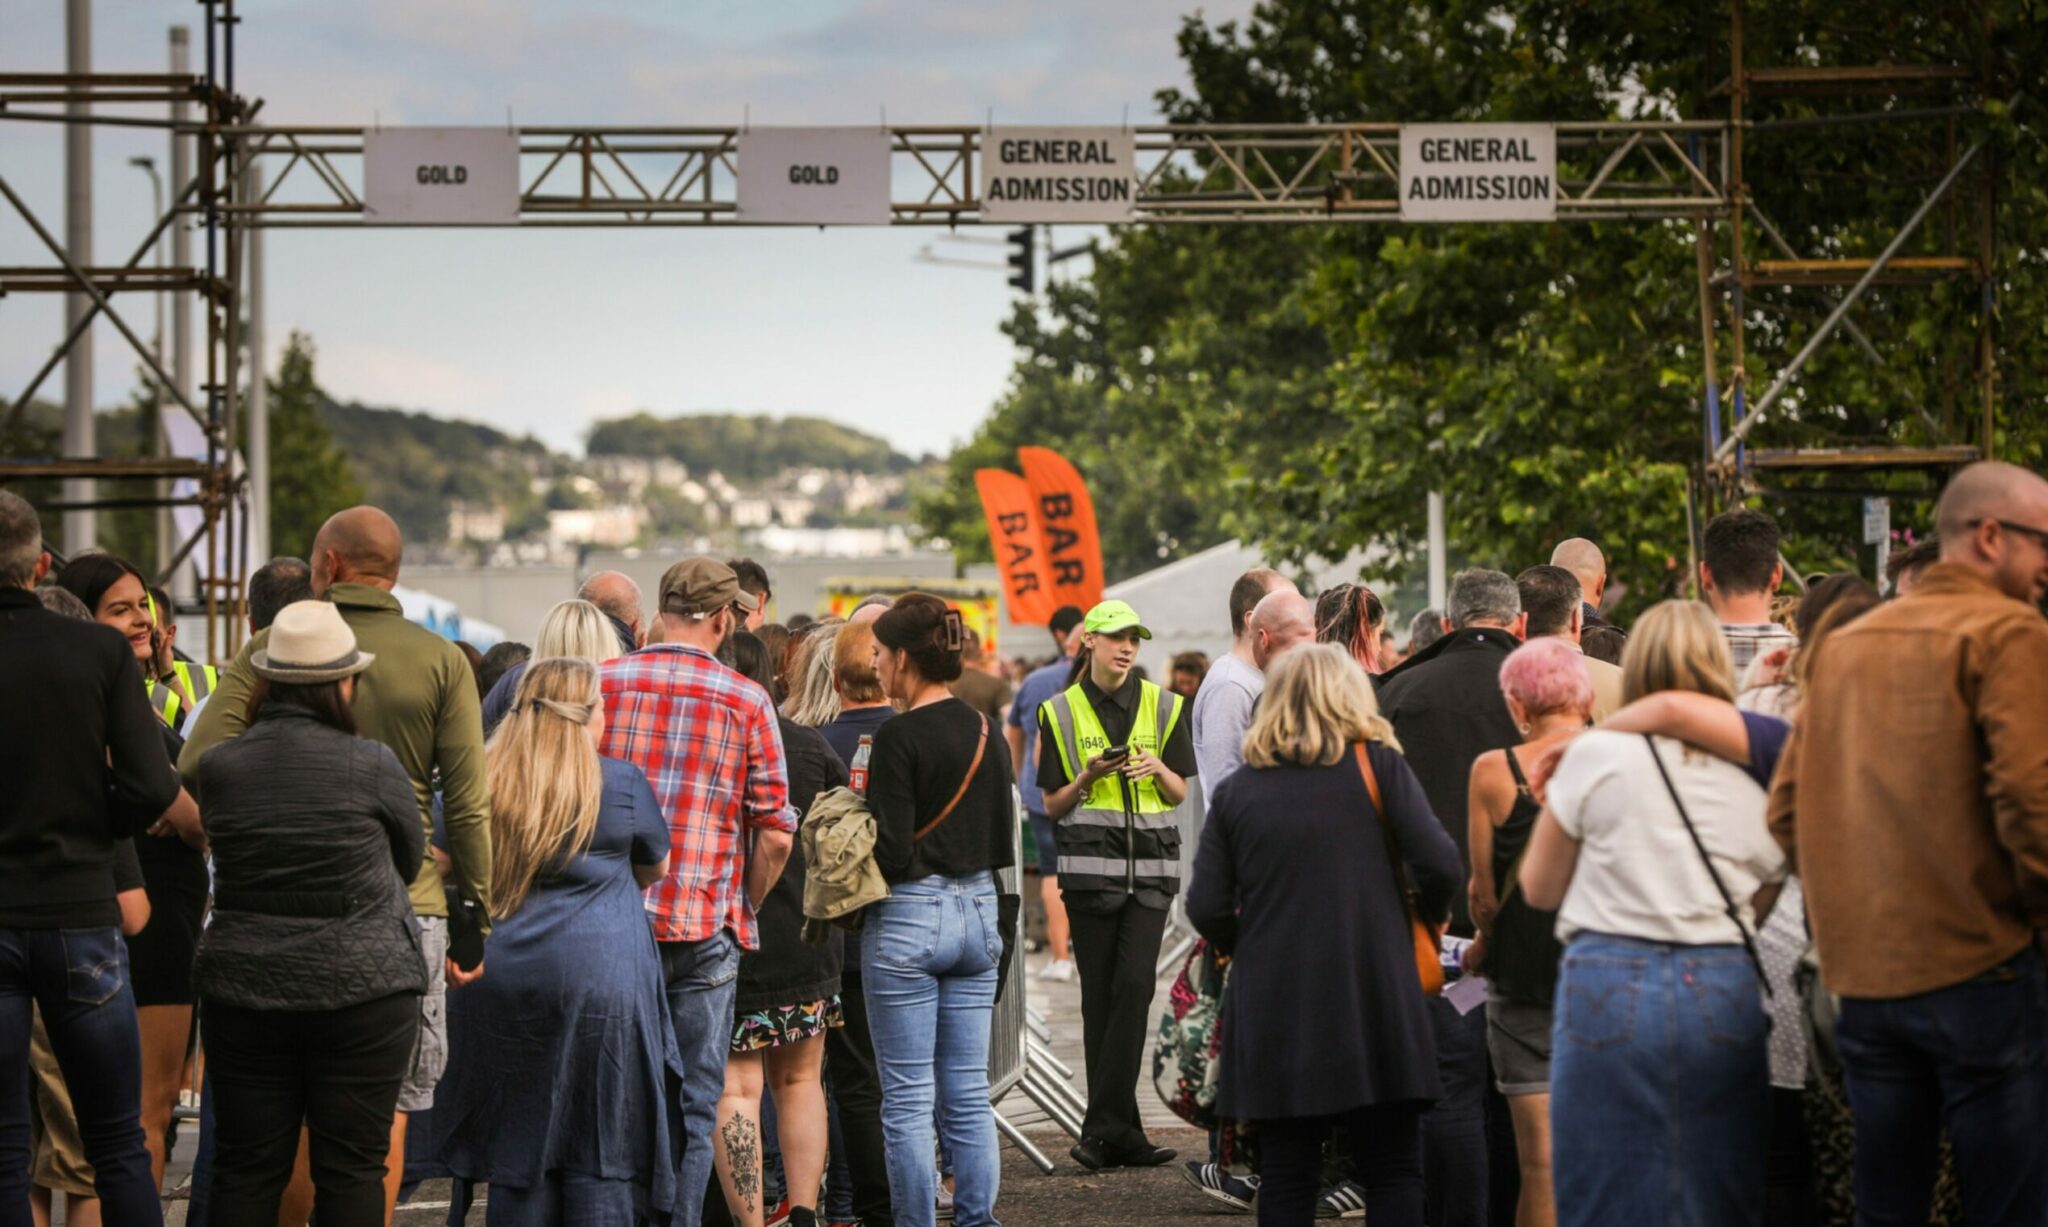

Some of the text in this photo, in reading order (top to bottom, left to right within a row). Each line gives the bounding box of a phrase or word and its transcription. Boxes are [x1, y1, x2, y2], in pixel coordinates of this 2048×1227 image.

[1000, 139, 1116, 164] GENERAL
[1420, 138, 1536, 163] GENERAL
[416, 165, 468, 185] GOLD
[789, 165, 839, 185] GOLD
[1408, 175, 1550, 200] ADMISSION
[988, 177, 1130, 202] ADMISSION
[1041, 493, 1085, 587] BAR
[997, 511, 1039, 597] BAR
[1080, 736, 1105, 750] 1648
